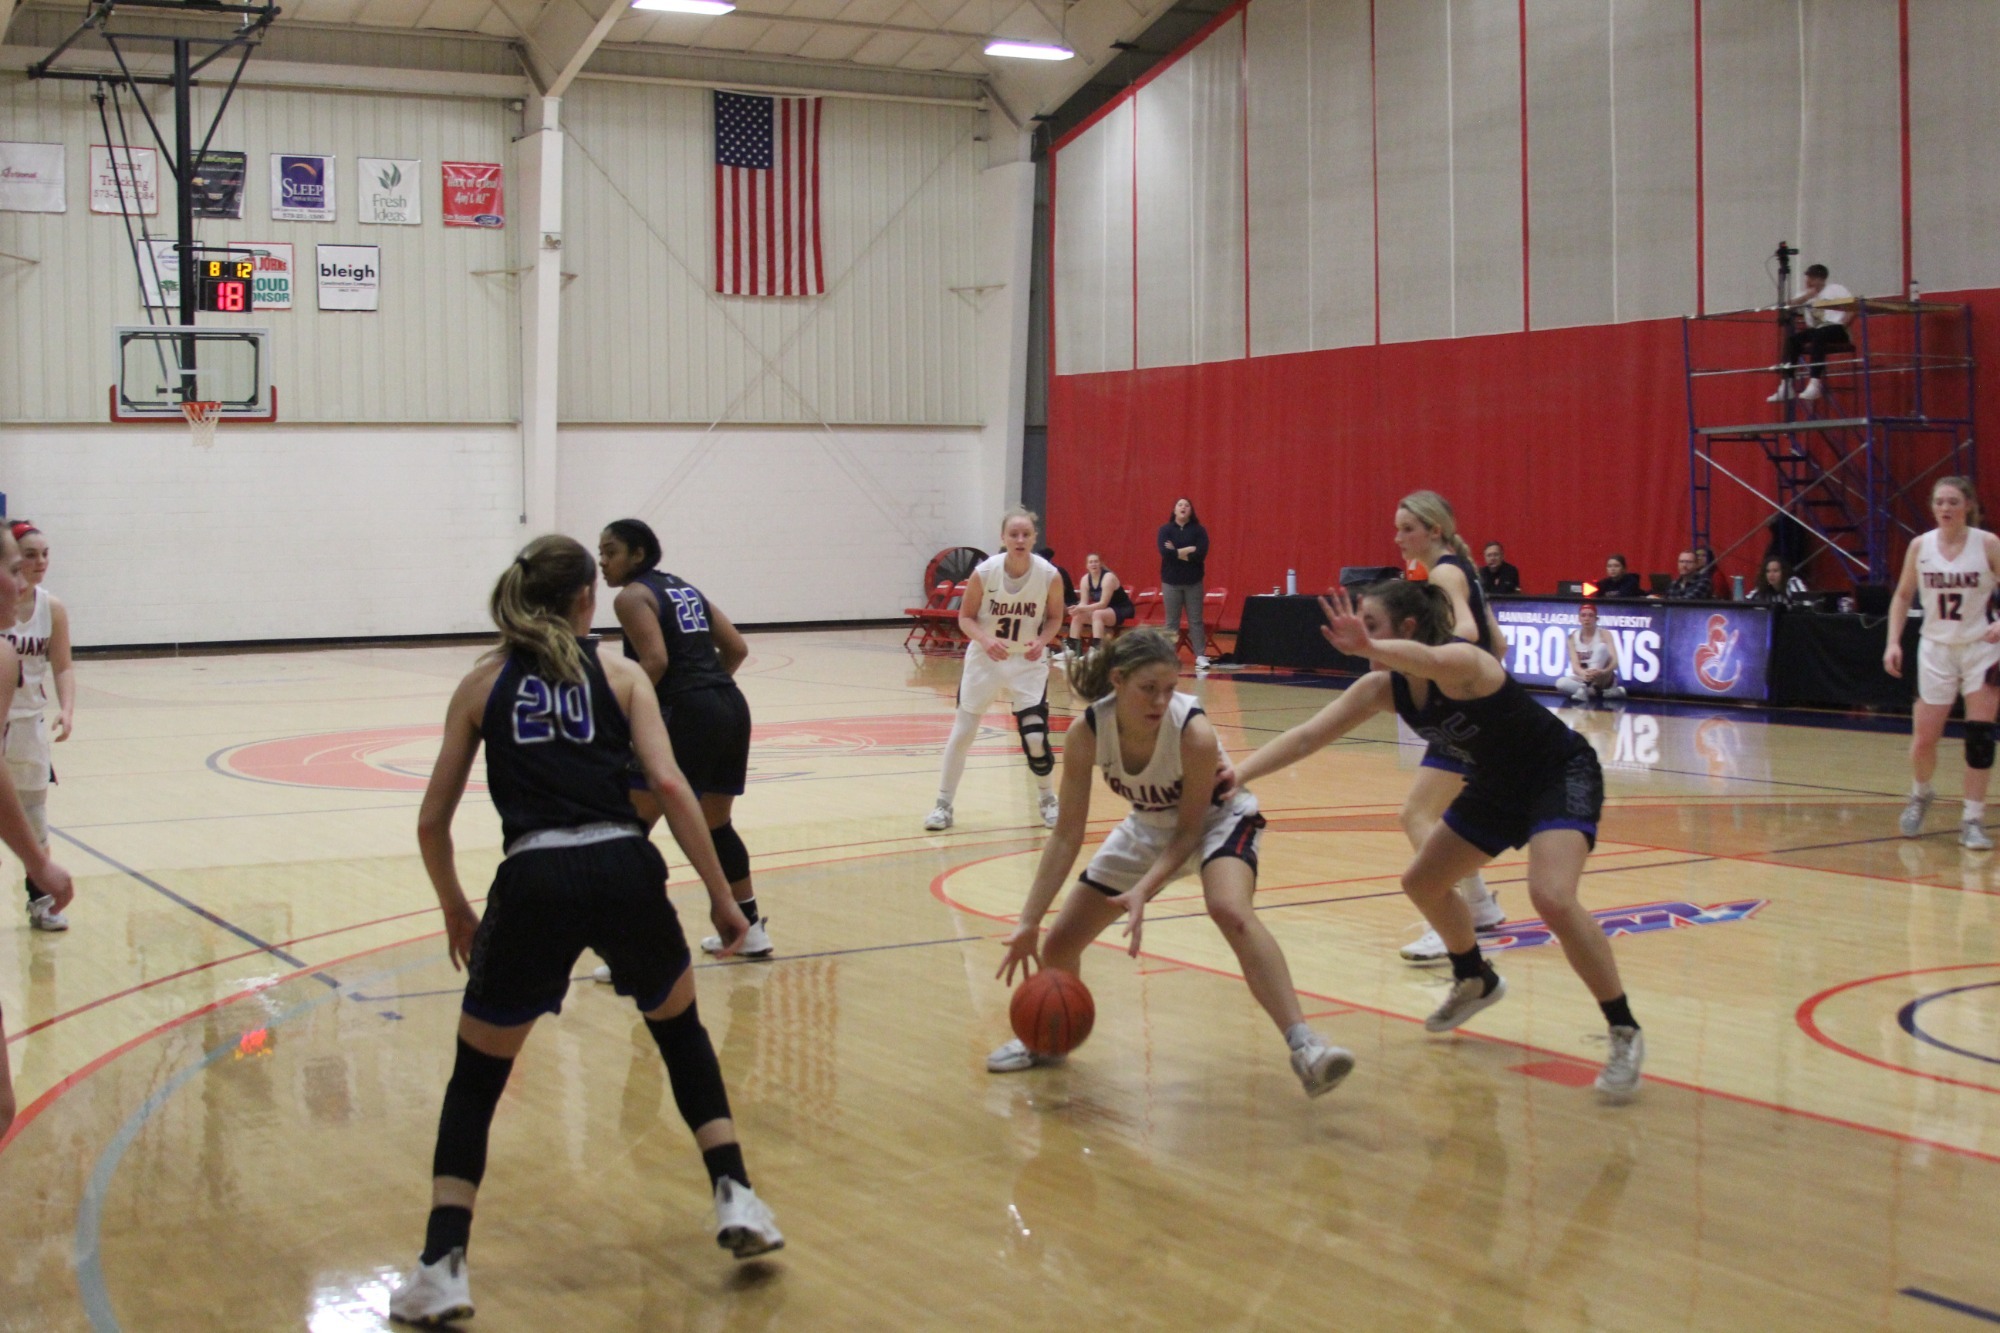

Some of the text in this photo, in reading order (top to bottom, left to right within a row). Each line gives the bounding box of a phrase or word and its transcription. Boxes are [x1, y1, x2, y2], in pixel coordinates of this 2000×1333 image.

[99, 175, 149, 191] Truckng
[282, 177, 324, 198] SLEEP
[373, 194, 407, 207] Fresh
[374, 208, 407, 222] Ideas
[321, 263, 375, 281] bleigh
[253, 278, 289, 291] OUD
[217, 281, 245, 311] 18
[252, 292, 290, 302] ONSOR
[665, 587, 710, 634] 22
[989, 599, 1038, 618] TROJANS
[1937, 593, 1963, 621] 12
[995, 617, 1022, 642] 31
[1498, 624, 1661, 683] TRONS
[512, 675, 595, 745] 20
